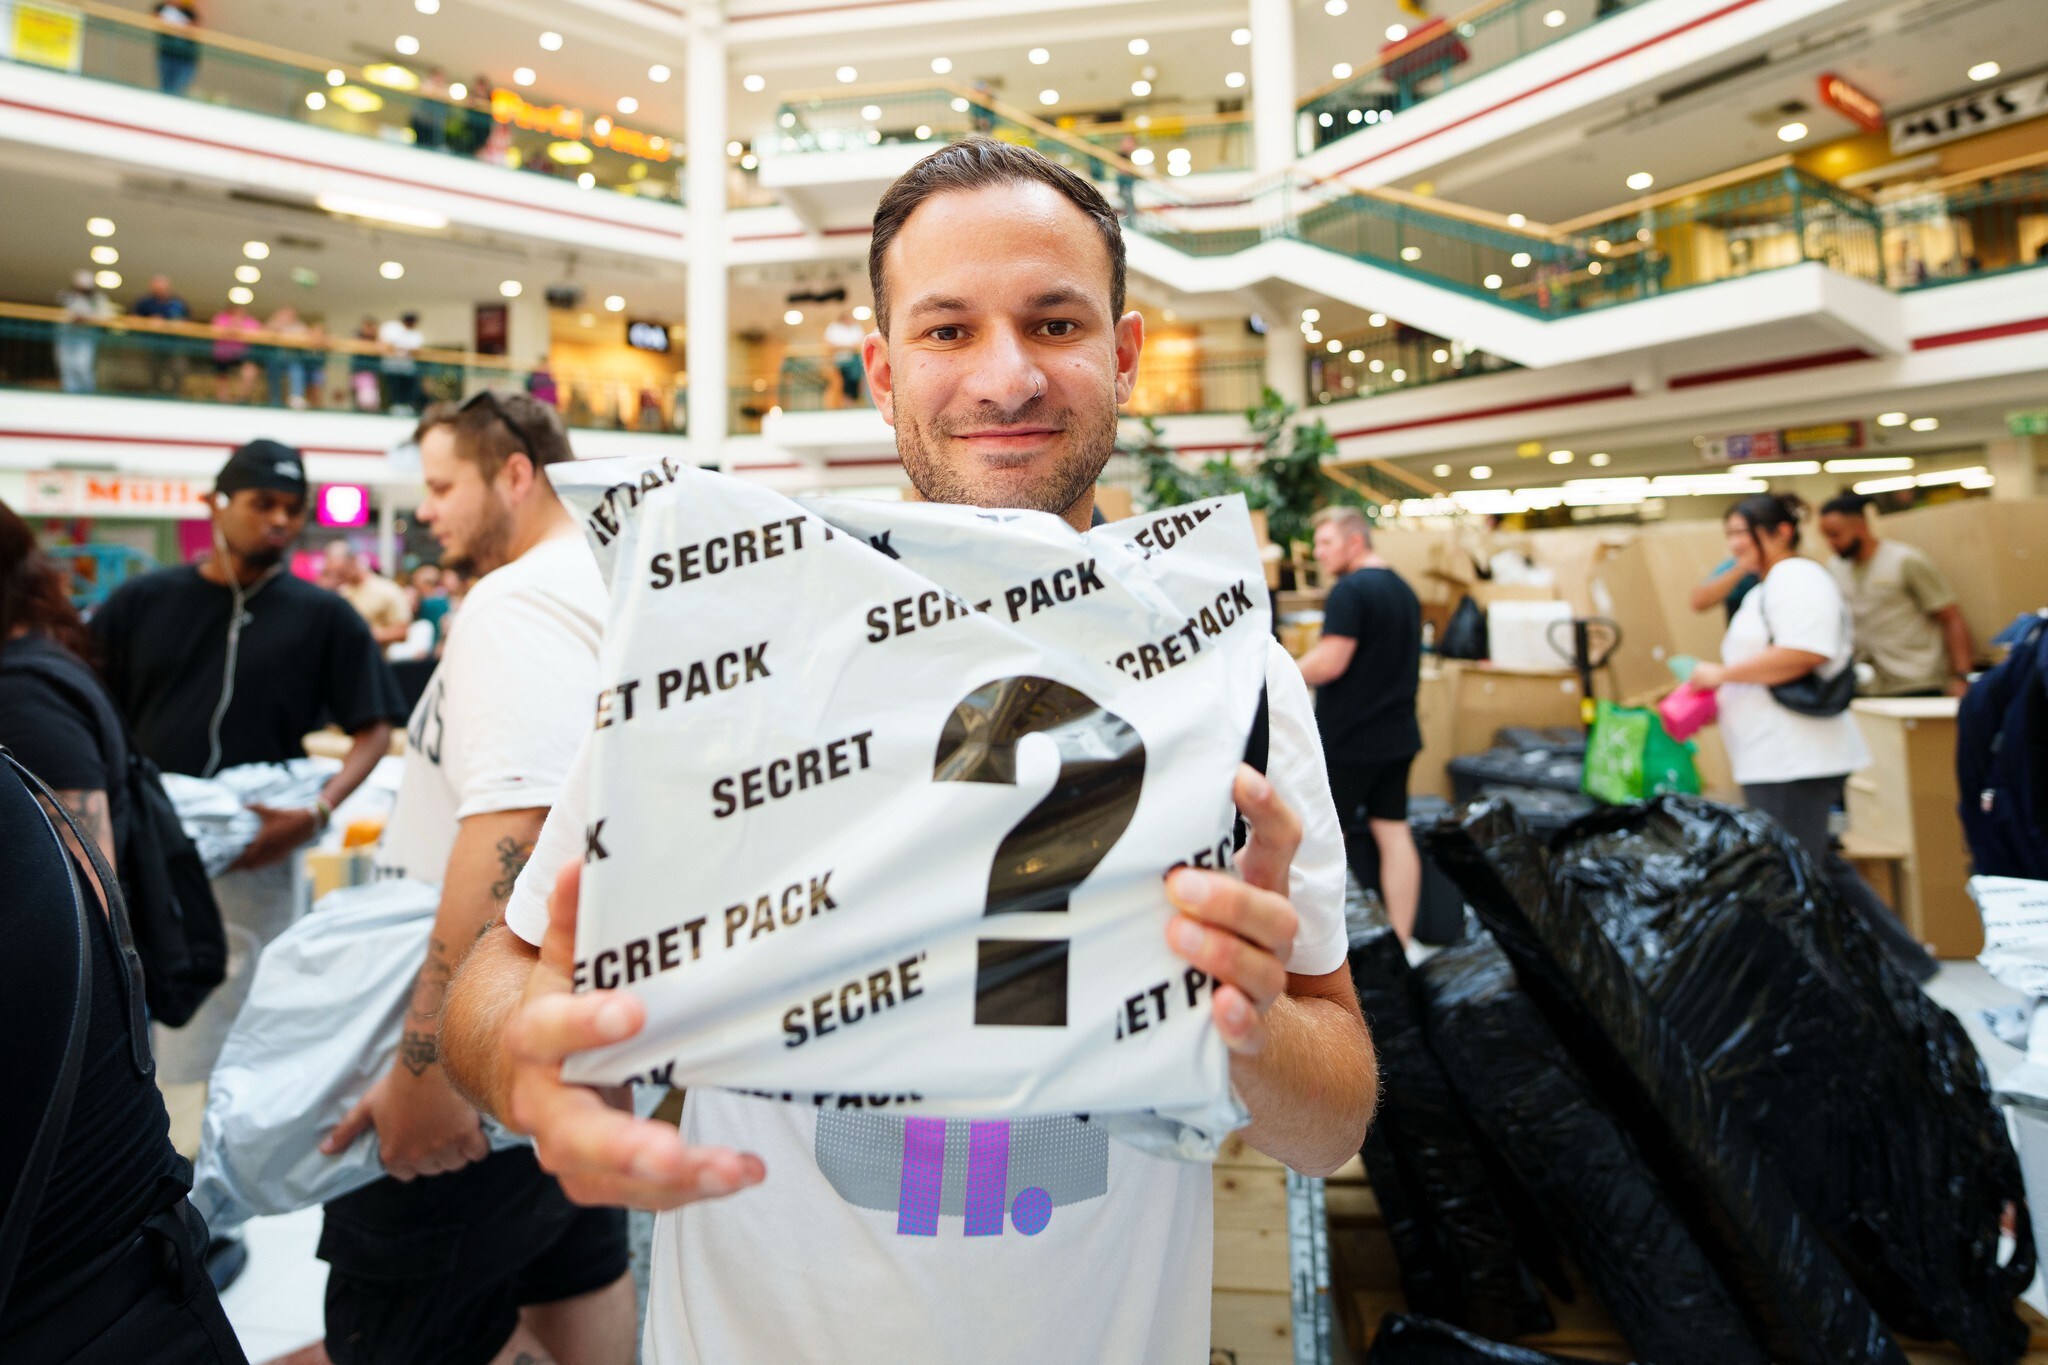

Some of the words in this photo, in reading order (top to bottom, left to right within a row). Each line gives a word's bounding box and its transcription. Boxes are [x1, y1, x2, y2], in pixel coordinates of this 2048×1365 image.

[651, 515, 808, 590] SECRET
[1005, 559, 1105, 623] PACK
[658, 642, 773, 710] PACK
[711, 730, 874, 819] SECRET
[725, 870, 839, 949] PACK
[783, 951, 926, 1049] SECRE
[1114, 982, 1171, 1041] ET
[1183, 966, 1222, 1009] P
